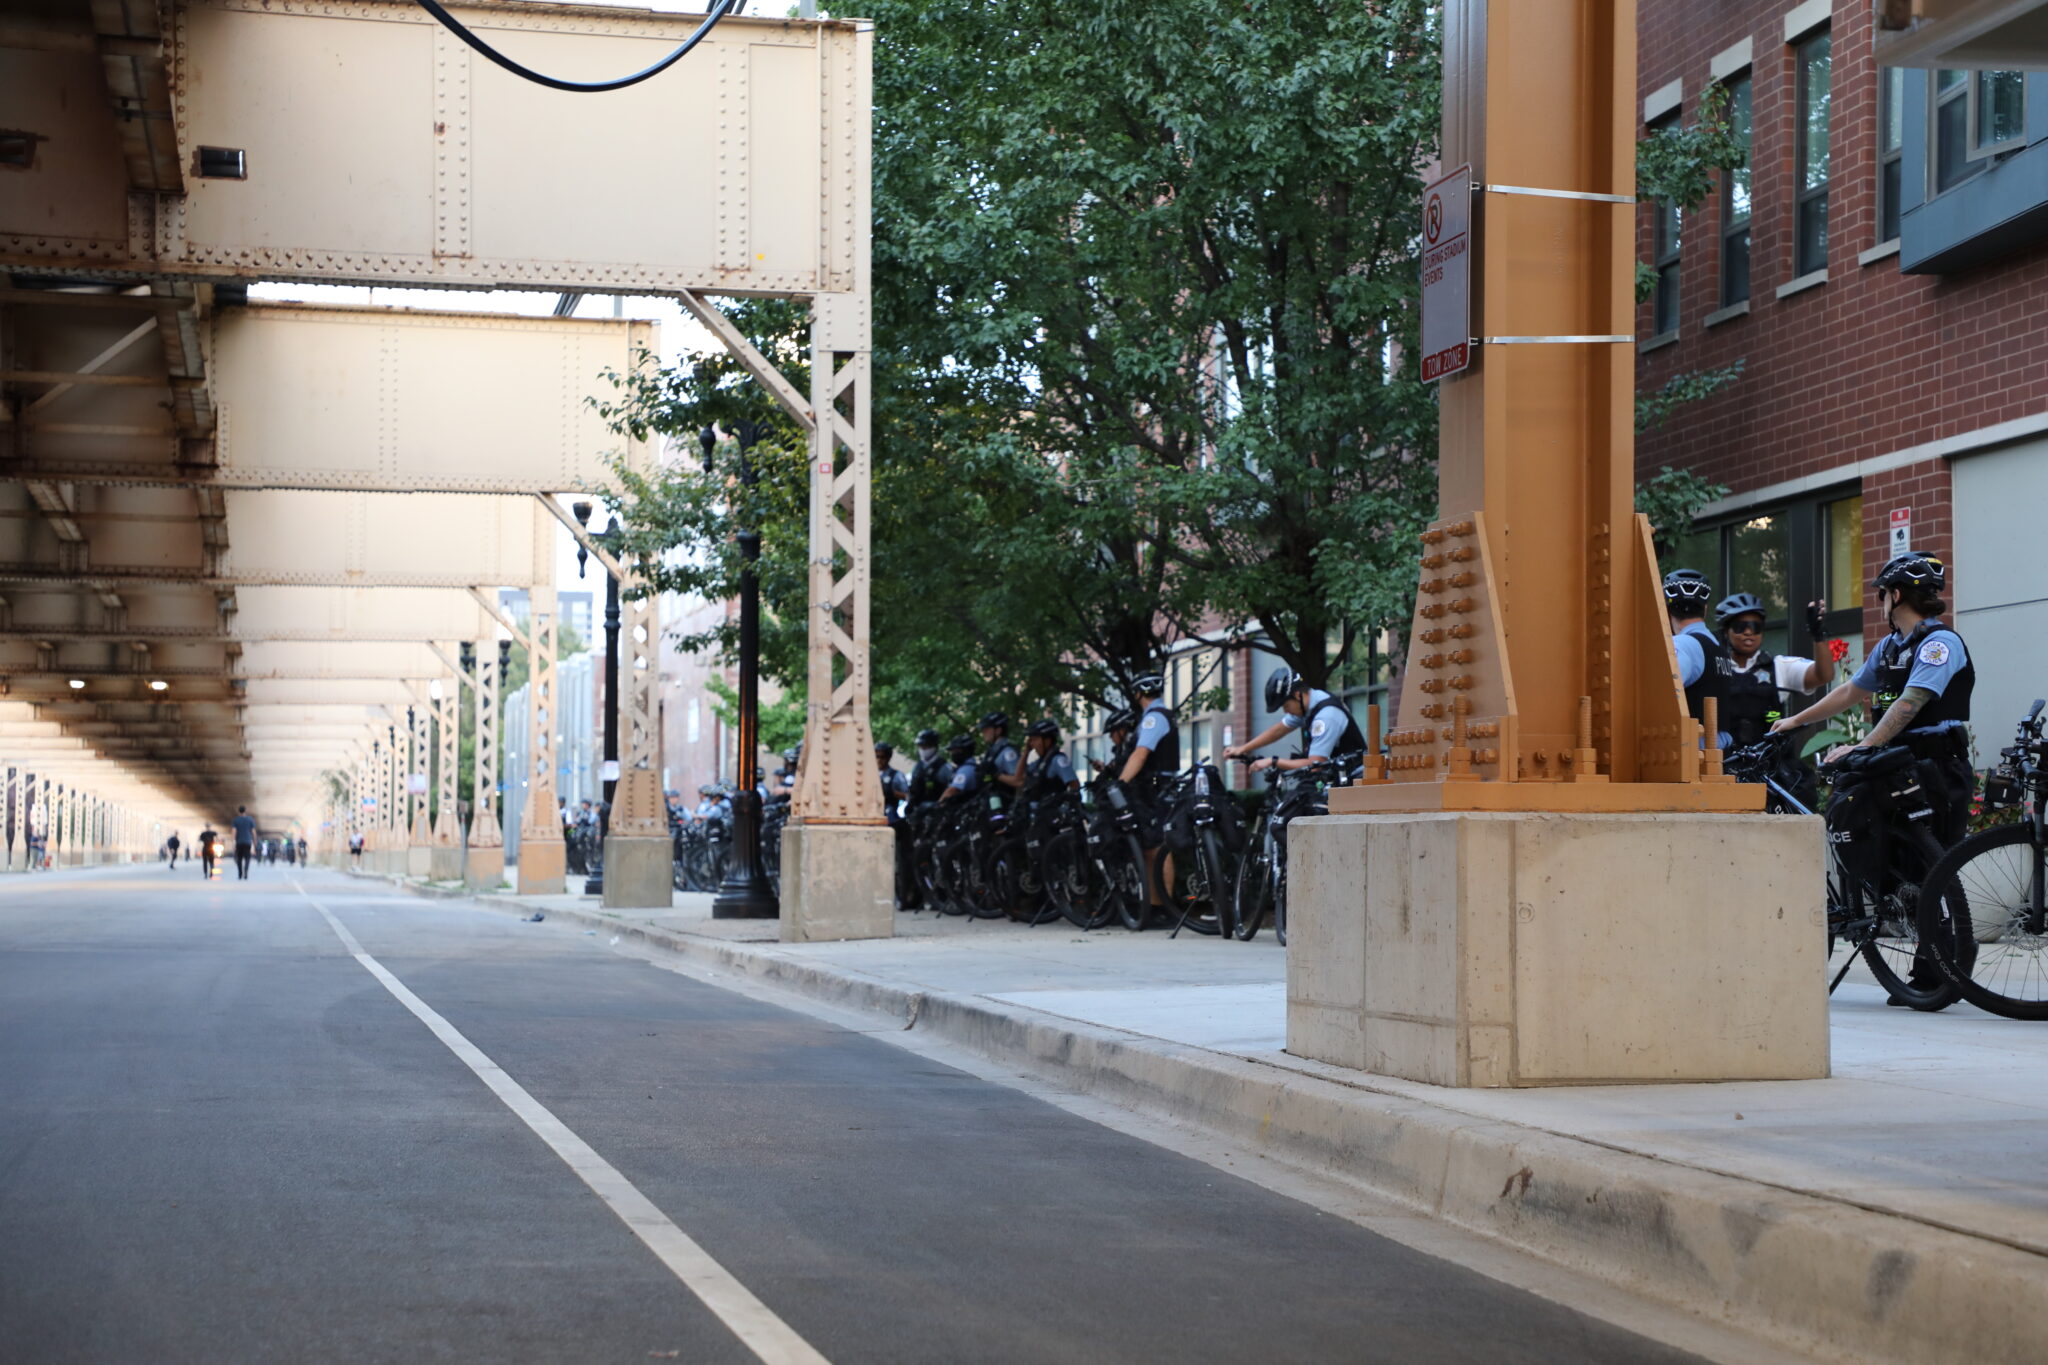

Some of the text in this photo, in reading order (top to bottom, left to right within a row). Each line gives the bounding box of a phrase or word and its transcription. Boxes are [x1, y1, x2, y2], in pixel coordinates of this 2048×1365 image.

[1425, 242, 1466, 270] DURING STADIUM
[1424, 266, 1443, 287] EVENTS
[1427, 348, 1462, 376] TOW ZONE
